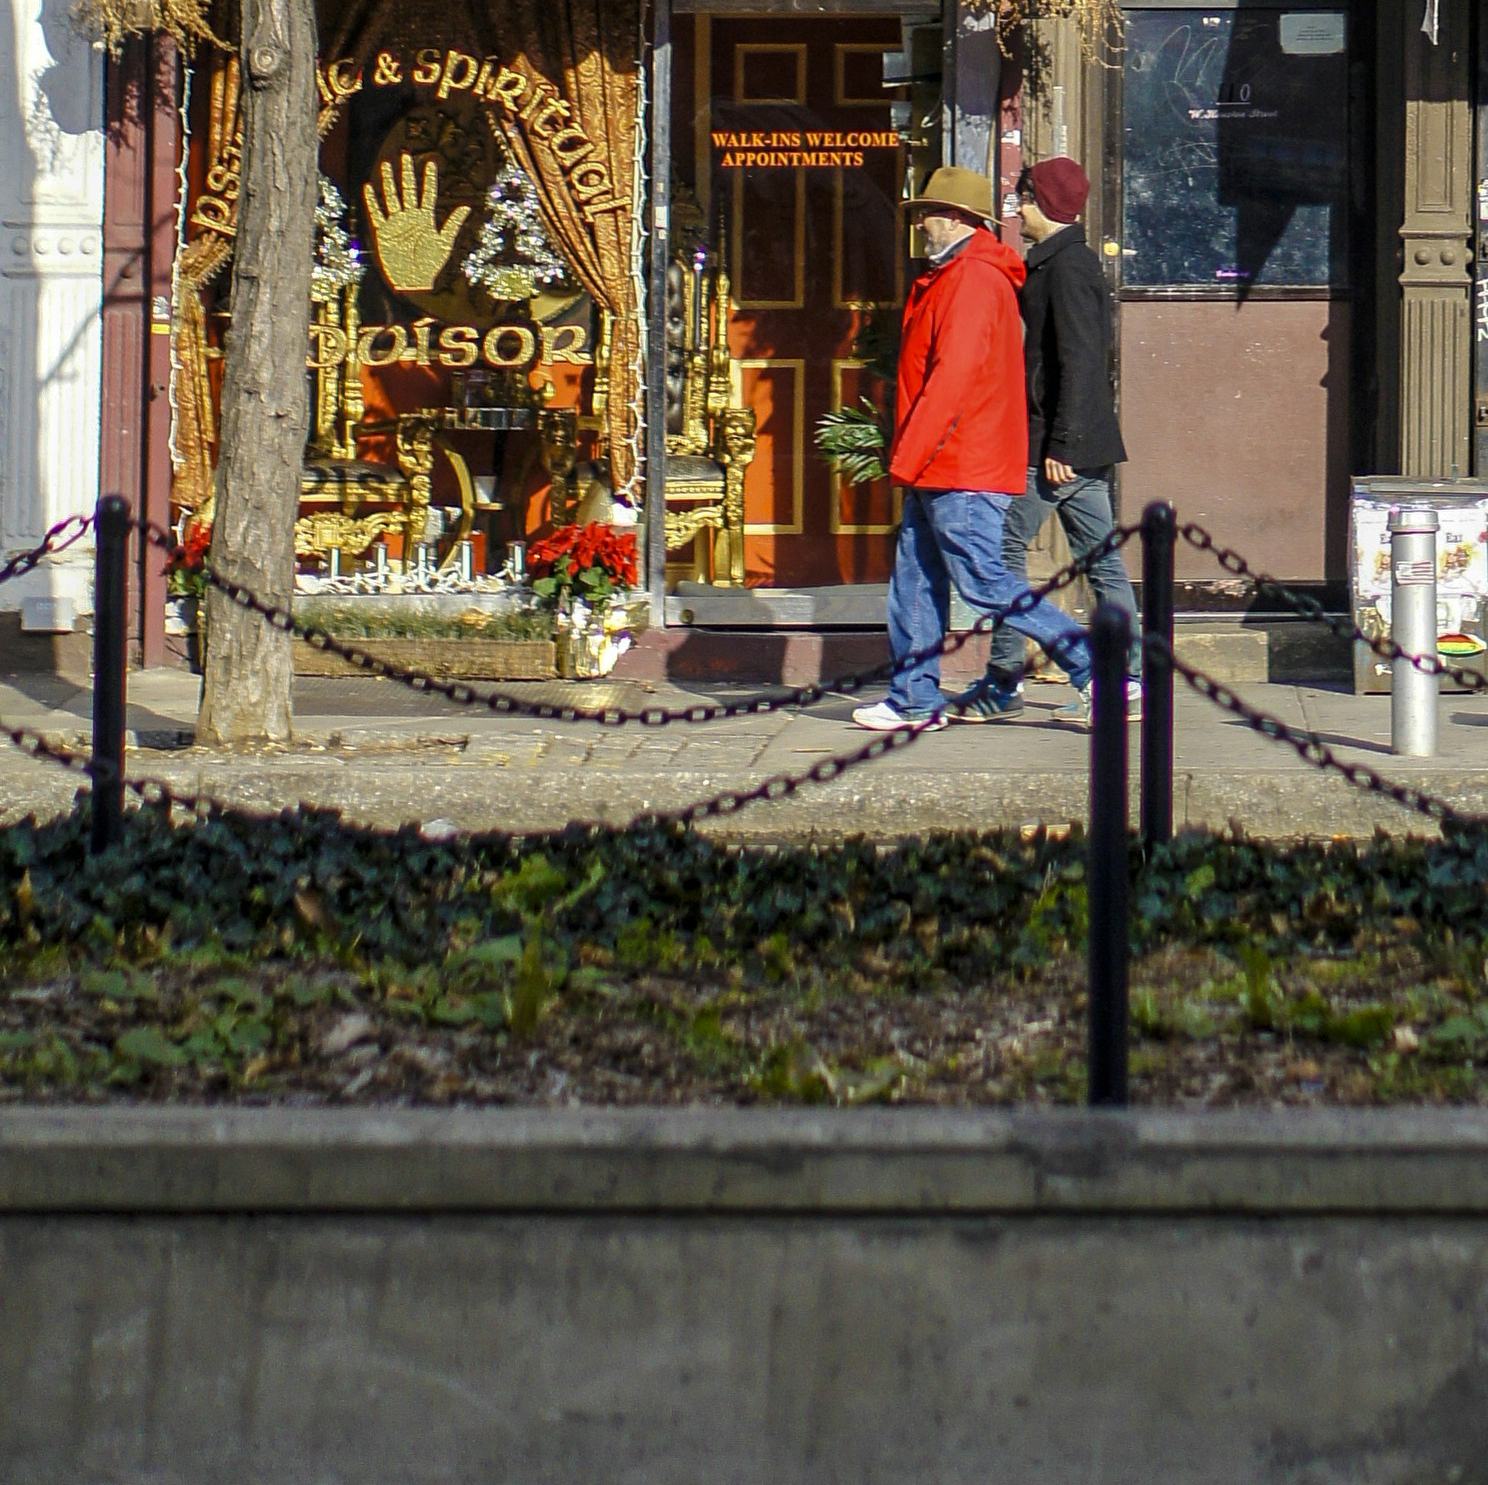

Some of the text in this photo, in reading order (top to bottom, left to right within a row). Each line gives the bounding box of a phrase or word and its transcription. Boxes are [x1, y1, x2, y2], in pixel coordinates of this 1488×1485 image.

[373, 52, 402, 85] &
[711, 132, 900, 147] WALK-INS WELCOME
[721, 151, 864, 167] APPOINTMENTS
